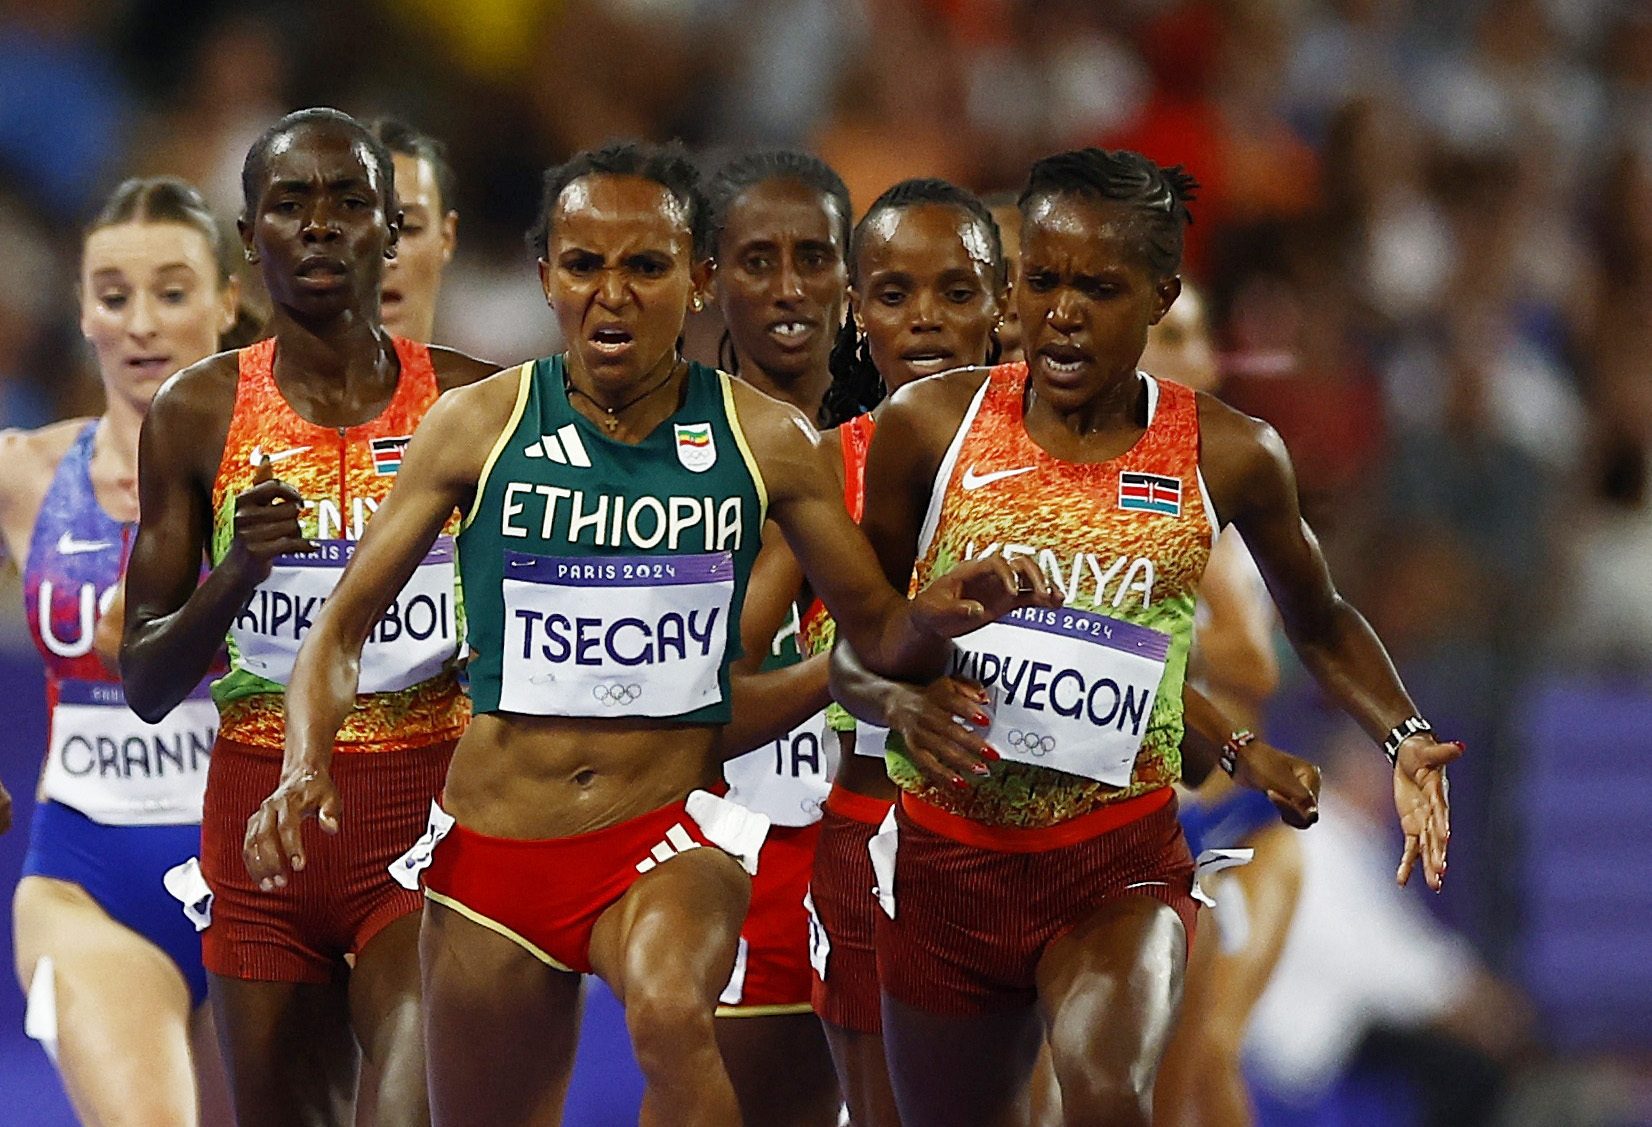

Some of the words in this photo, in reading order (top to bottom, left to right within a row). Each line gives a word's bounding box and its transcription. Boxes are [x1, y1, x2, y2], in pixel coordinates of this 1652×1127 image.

[502, 482, 742, 551] ETHIOPIA
[558, 564, 616, 580] PARIS
[623, 563, 676, 579] 2024
[38, 579, 120, 658] U
[236, 589, 449, 644] KIPKBOI
[515, 606, 720, 666] TSEGAY
[1062, 615, 1113, 640] 2024
